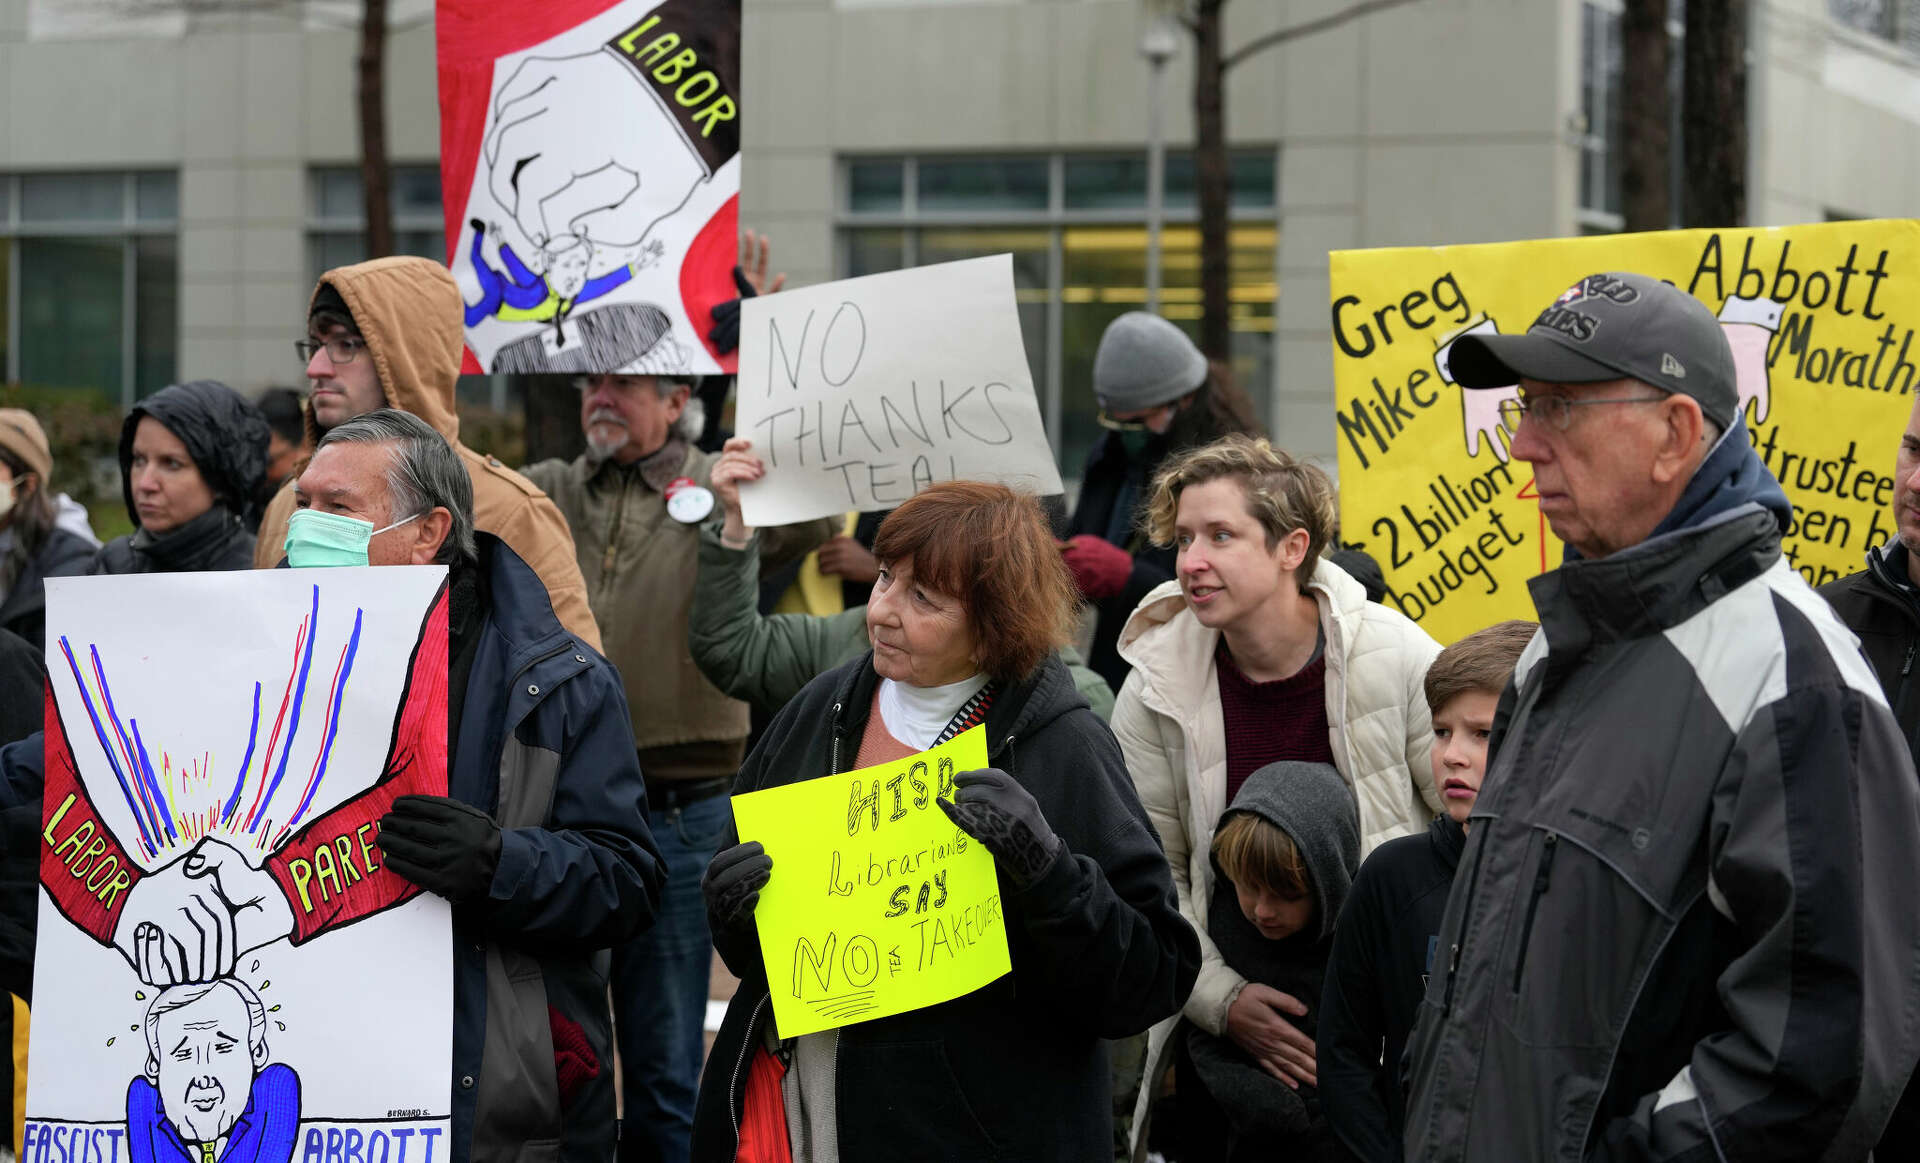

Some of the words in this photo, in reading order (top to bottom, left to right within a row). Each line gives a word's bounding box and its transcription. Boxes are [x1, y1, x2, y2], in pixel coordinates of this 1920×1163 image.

[618, 16, 736, 137] LABOR
[1331, 272, 1471, 358] Greg
[1689, 233, 1890, 321] Abbott
[767, 301, 866, 397] NO
[1768, 312, 1917, 395] Morath
[755, 379, 1013, 467] THANKS
[1337, 368, 1440, 470] Mike
[1400, 461, 1516, 552] billion
[1384, 507, 1525, 623] budget
[847, 757, 954, 837] HISD
[43, 794, 132, 909] LABOR
[289, 819, 388, 914] PARE
[885, 869, 947, 918] SAY
[792, 931, 879, 998] NO
[889, 944, 902, 978] TEA
[910, 894, 1001, 972] TAKEOVER
[22, 1124, 125, 1163] FASCIST
